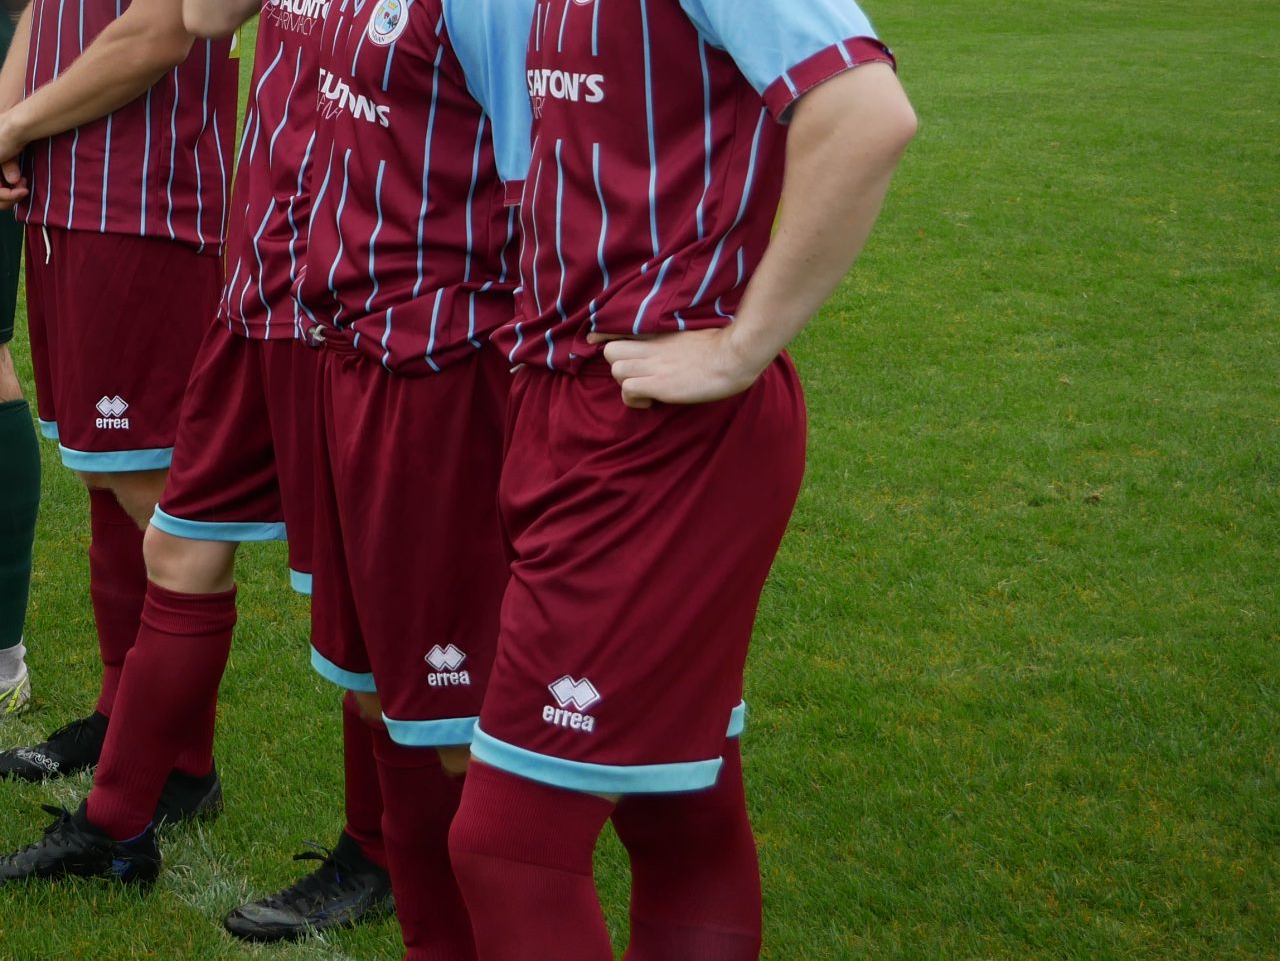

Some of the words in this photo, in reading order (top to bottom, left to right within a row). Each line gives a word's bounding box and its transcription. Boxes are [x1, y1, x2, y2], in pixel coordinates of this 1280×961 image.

[95, 417, 129, 430] errea
[427, 669, 471, 687] errea
[542, 704, 596, 732] errea
